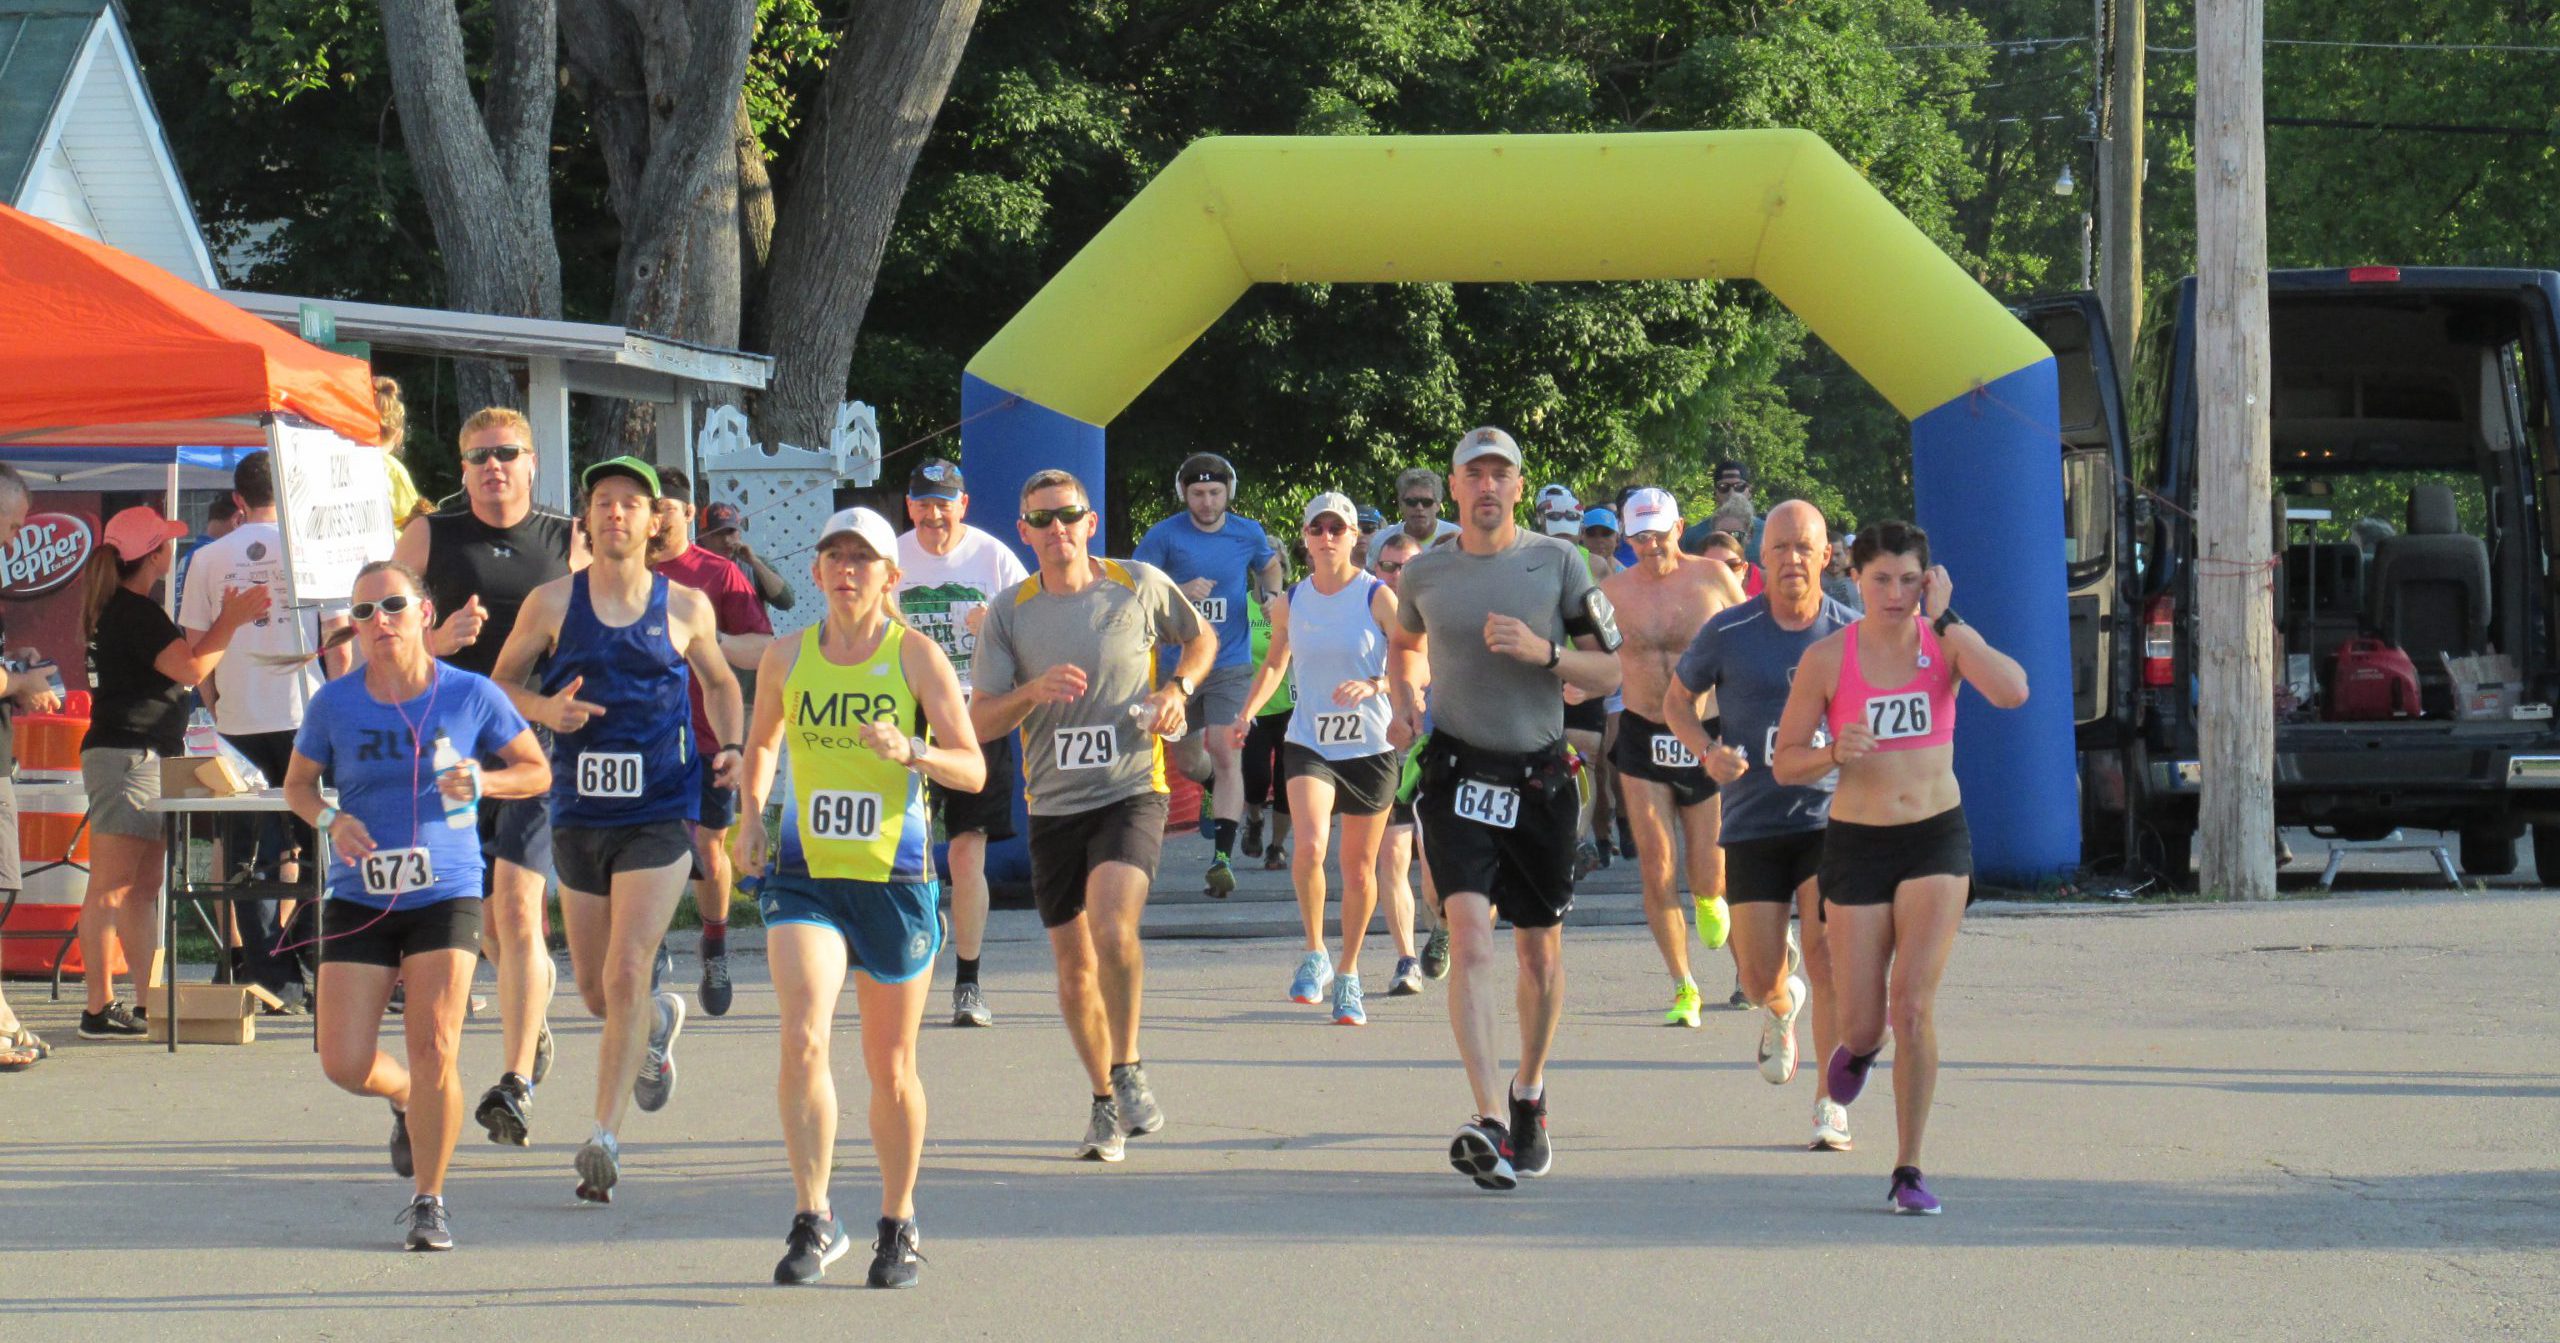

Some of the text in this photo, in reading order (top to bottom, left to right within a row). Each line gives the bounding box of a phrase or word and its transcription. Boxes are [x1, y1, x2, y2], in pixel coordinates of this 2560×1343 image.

[19, 523, 57, 557] Dr
[0, 530, 83, 589] Pepper
[798, 690, 899, 727] MR8
[1870, 697, 1926, 736] 726
[1318, 714, 1362, 743] 722
[1058, 730, 1113, 767] 729
[582, 757, 637, 793] 680
[812, 795, 876, 837] 690
[1460, 784, 1514, 824] 643
[367, 852, 426, 890] 673
